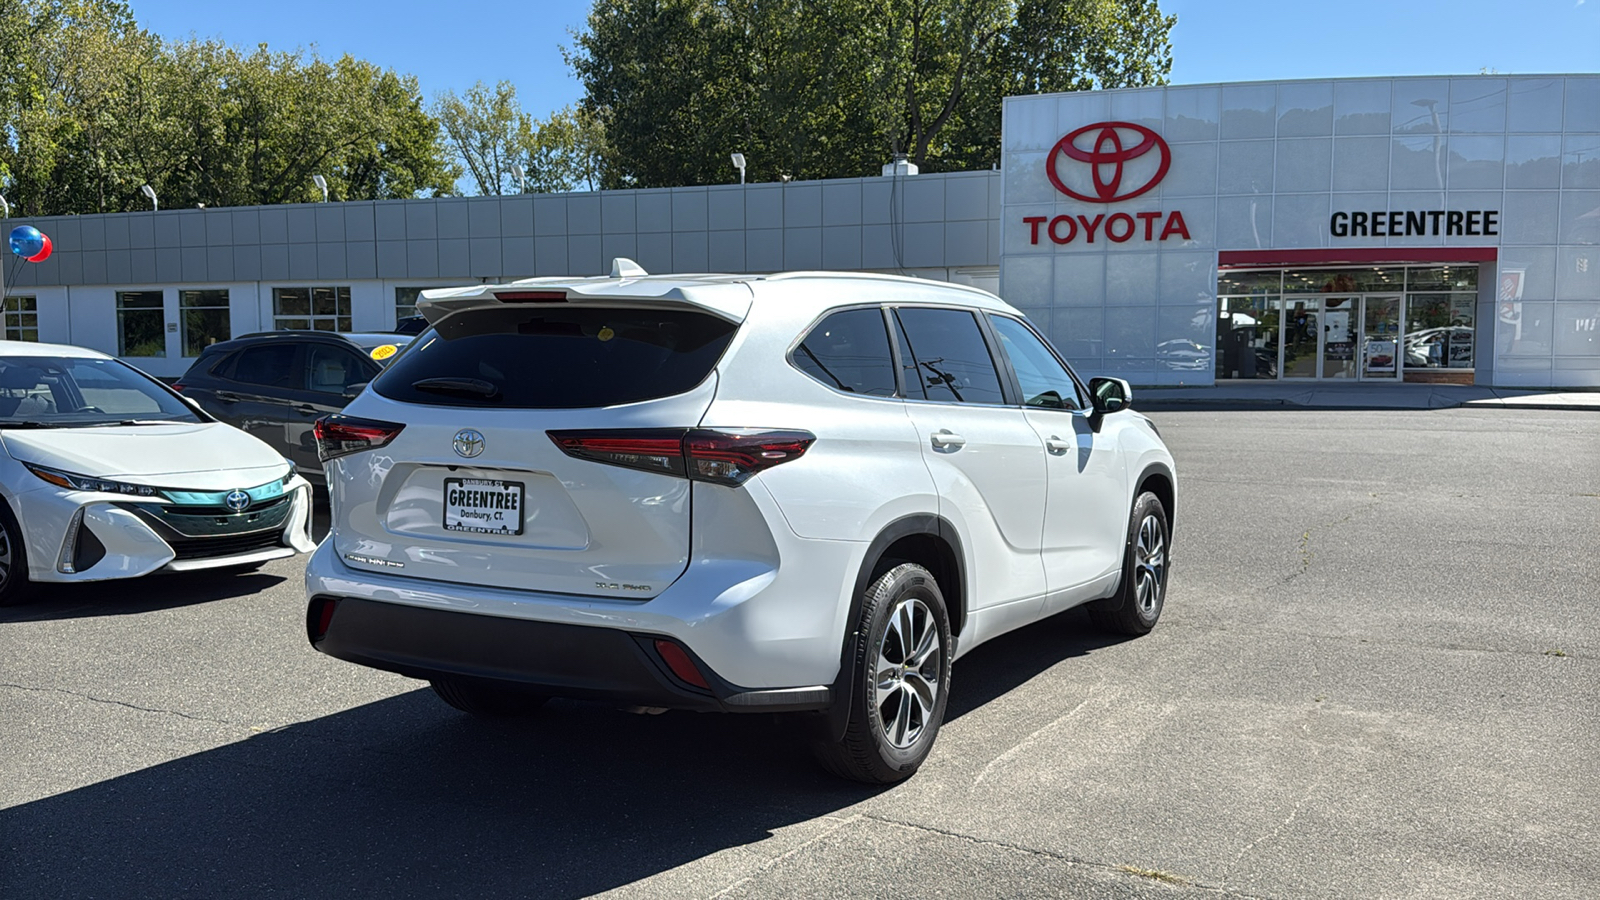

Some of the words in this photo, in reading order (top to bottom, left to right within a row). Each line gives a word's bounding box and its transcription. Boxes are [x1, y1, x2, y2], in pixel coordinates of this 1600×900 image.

[1023, 211, 1191, 244] TOYOTA
[1330, 210, 1498, 237] GREENTREE
[449, 489, 518, 510] GREENTREE
[460, 509, 492, 522] Danbury,
[493, 511, 504, 520] CT.
[447, 525, 516, 535] GREENTREE
